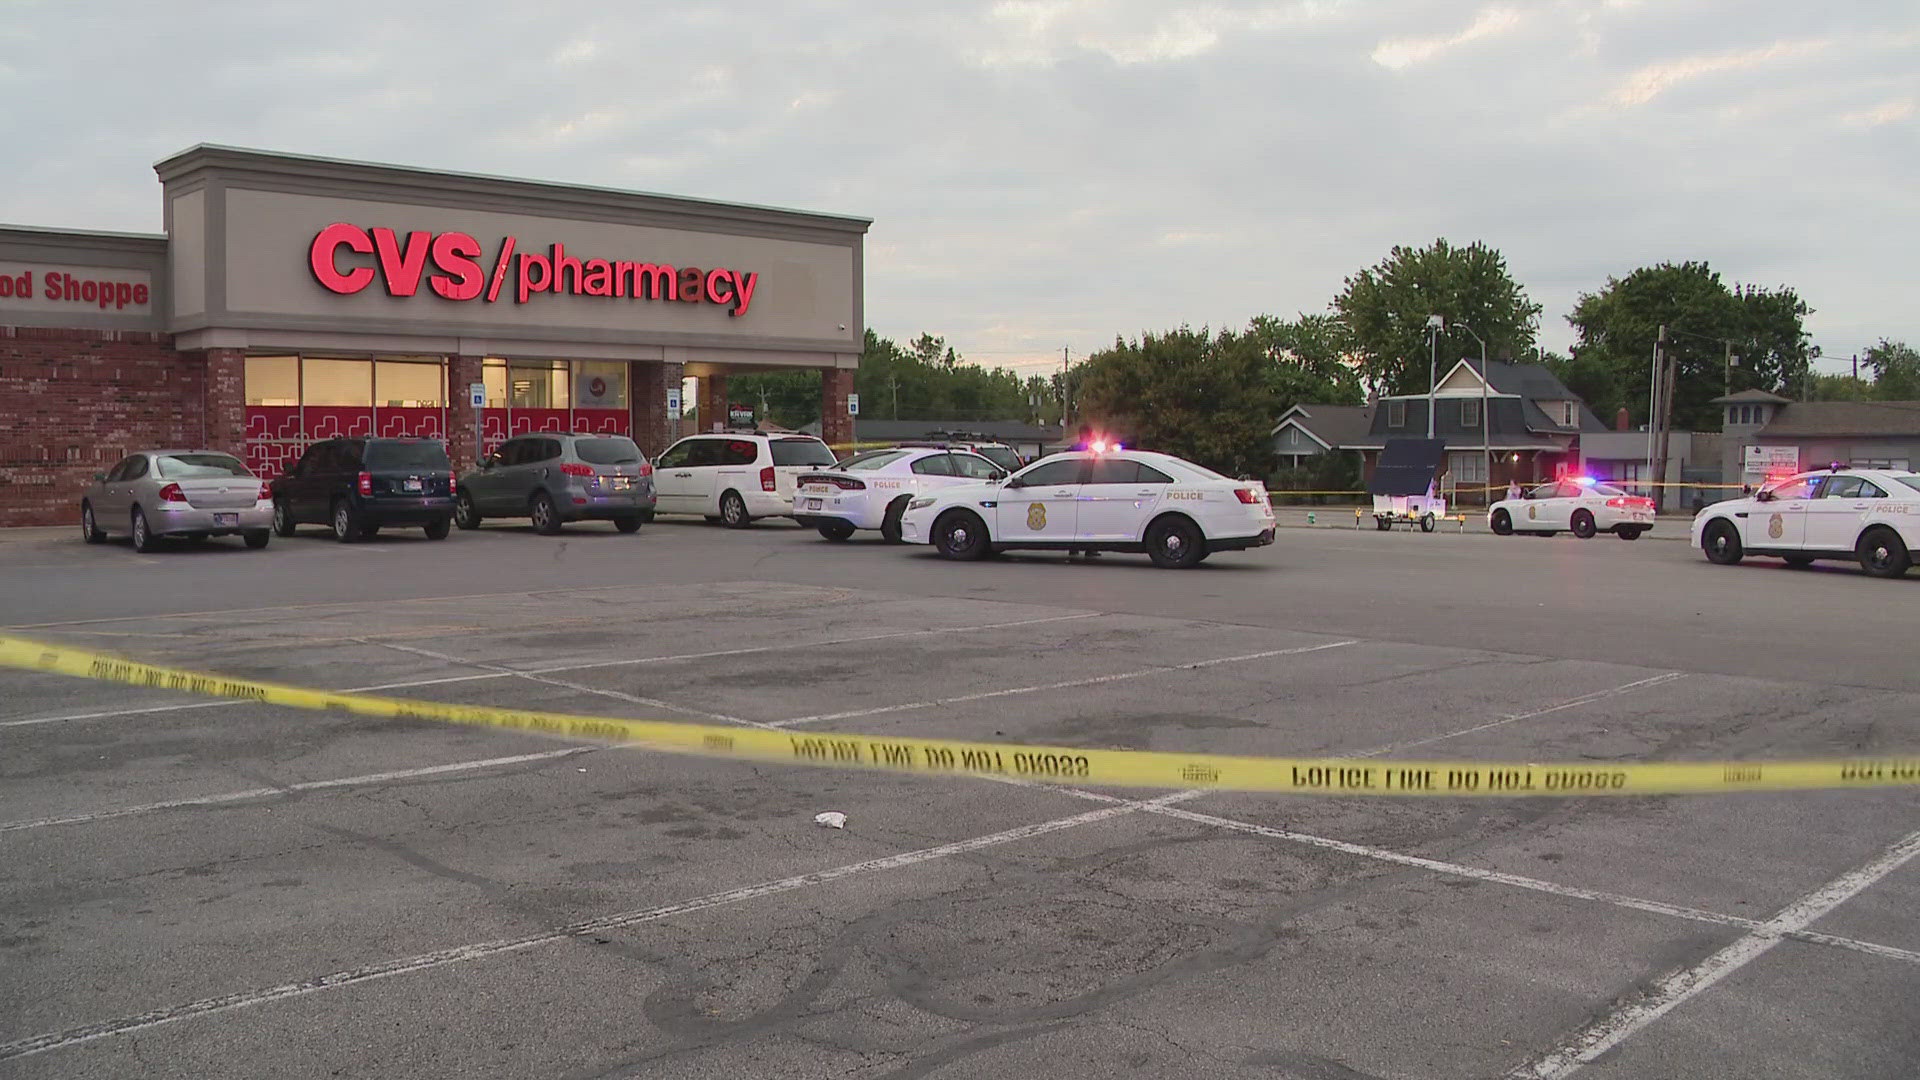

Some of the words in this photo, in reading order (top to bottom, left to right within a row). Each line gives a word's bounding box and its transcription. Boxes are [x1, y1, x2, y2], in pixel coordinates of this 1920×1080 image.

[45, 272, 148, 309] Shoppe
[873, 481, 900, 489] POLICE
[1166, 492, 1204, 500] POLICE
[1876, 505, 1909, 513] POLICE
